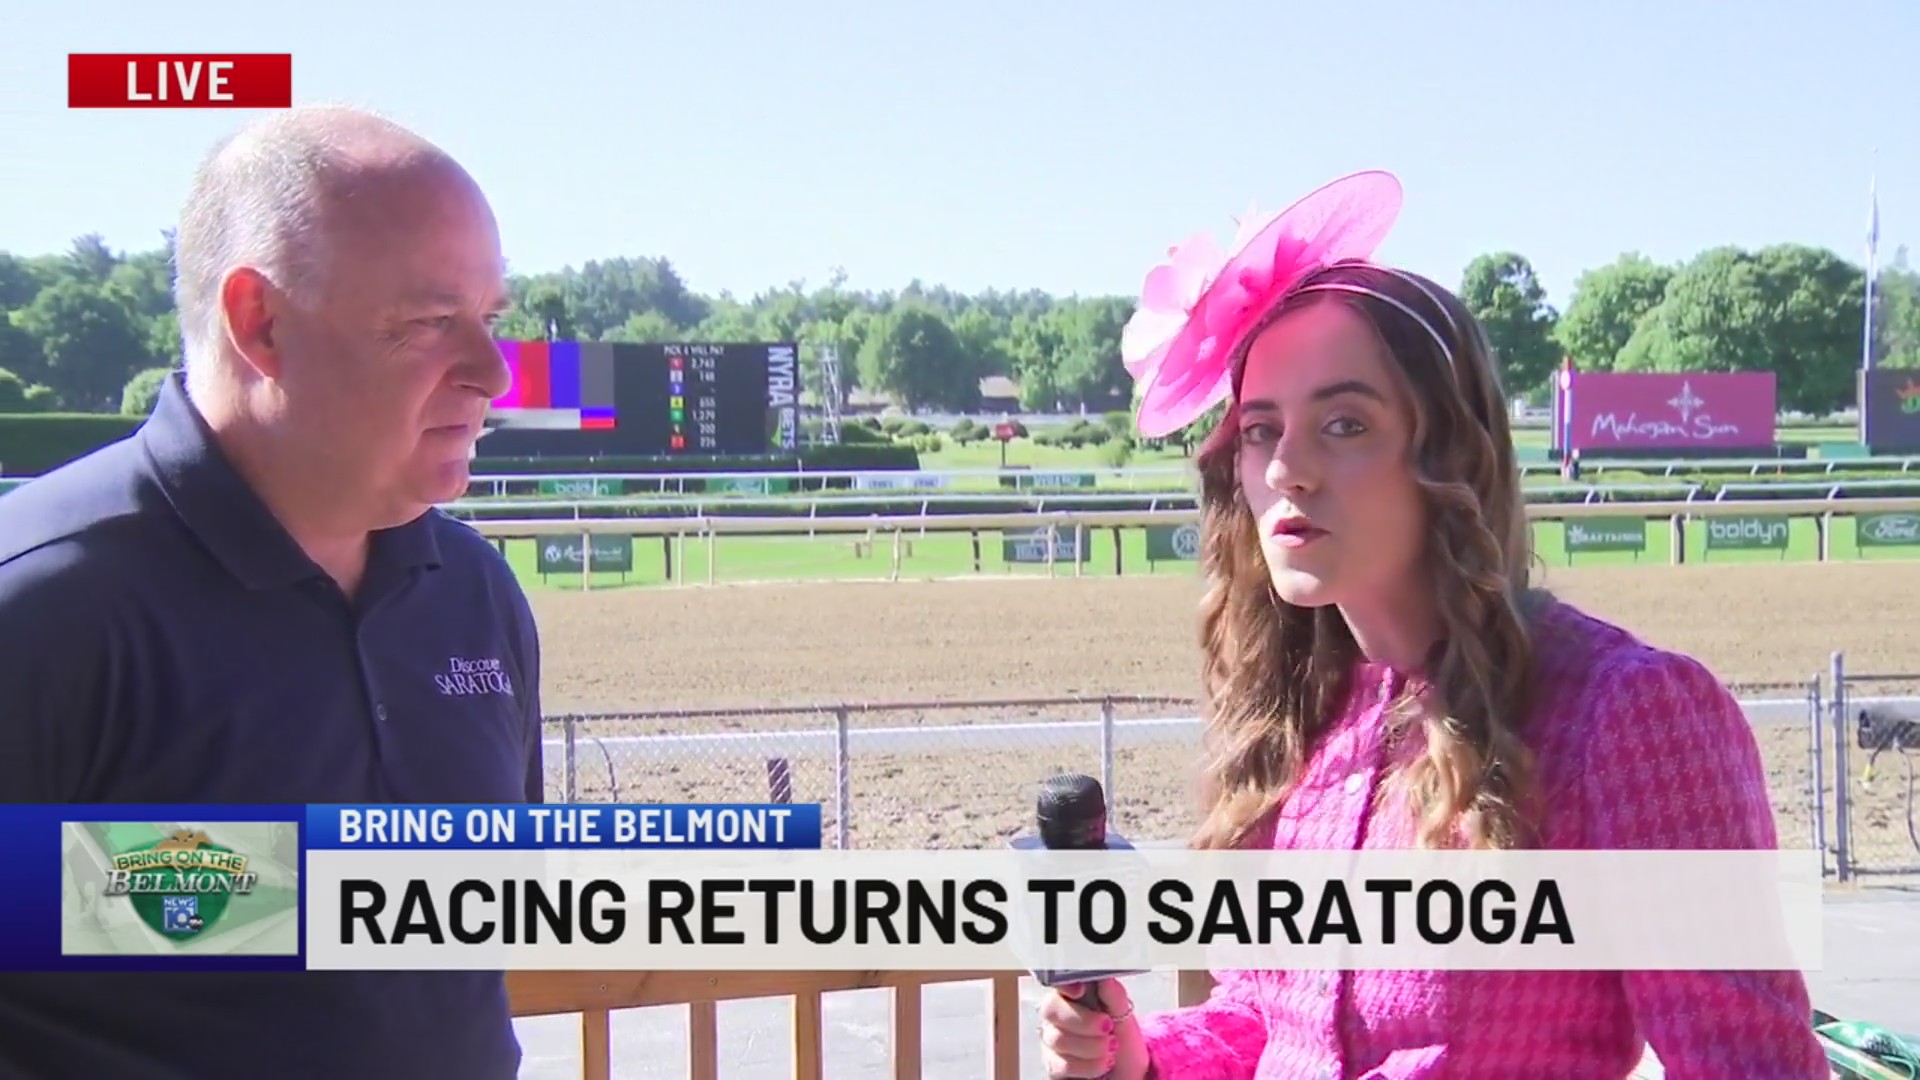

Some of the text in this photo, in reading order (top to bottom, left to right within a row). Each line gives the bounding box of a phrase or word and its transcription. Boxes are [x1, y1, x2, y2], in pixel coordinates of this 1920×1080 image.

[768, 346, 796, 451] NYRA BETS
[1692, 414, 1739, 439] Sun
[1710, 518, 1787, 544] boldyn
[450, 657, 500, 673] Discove
